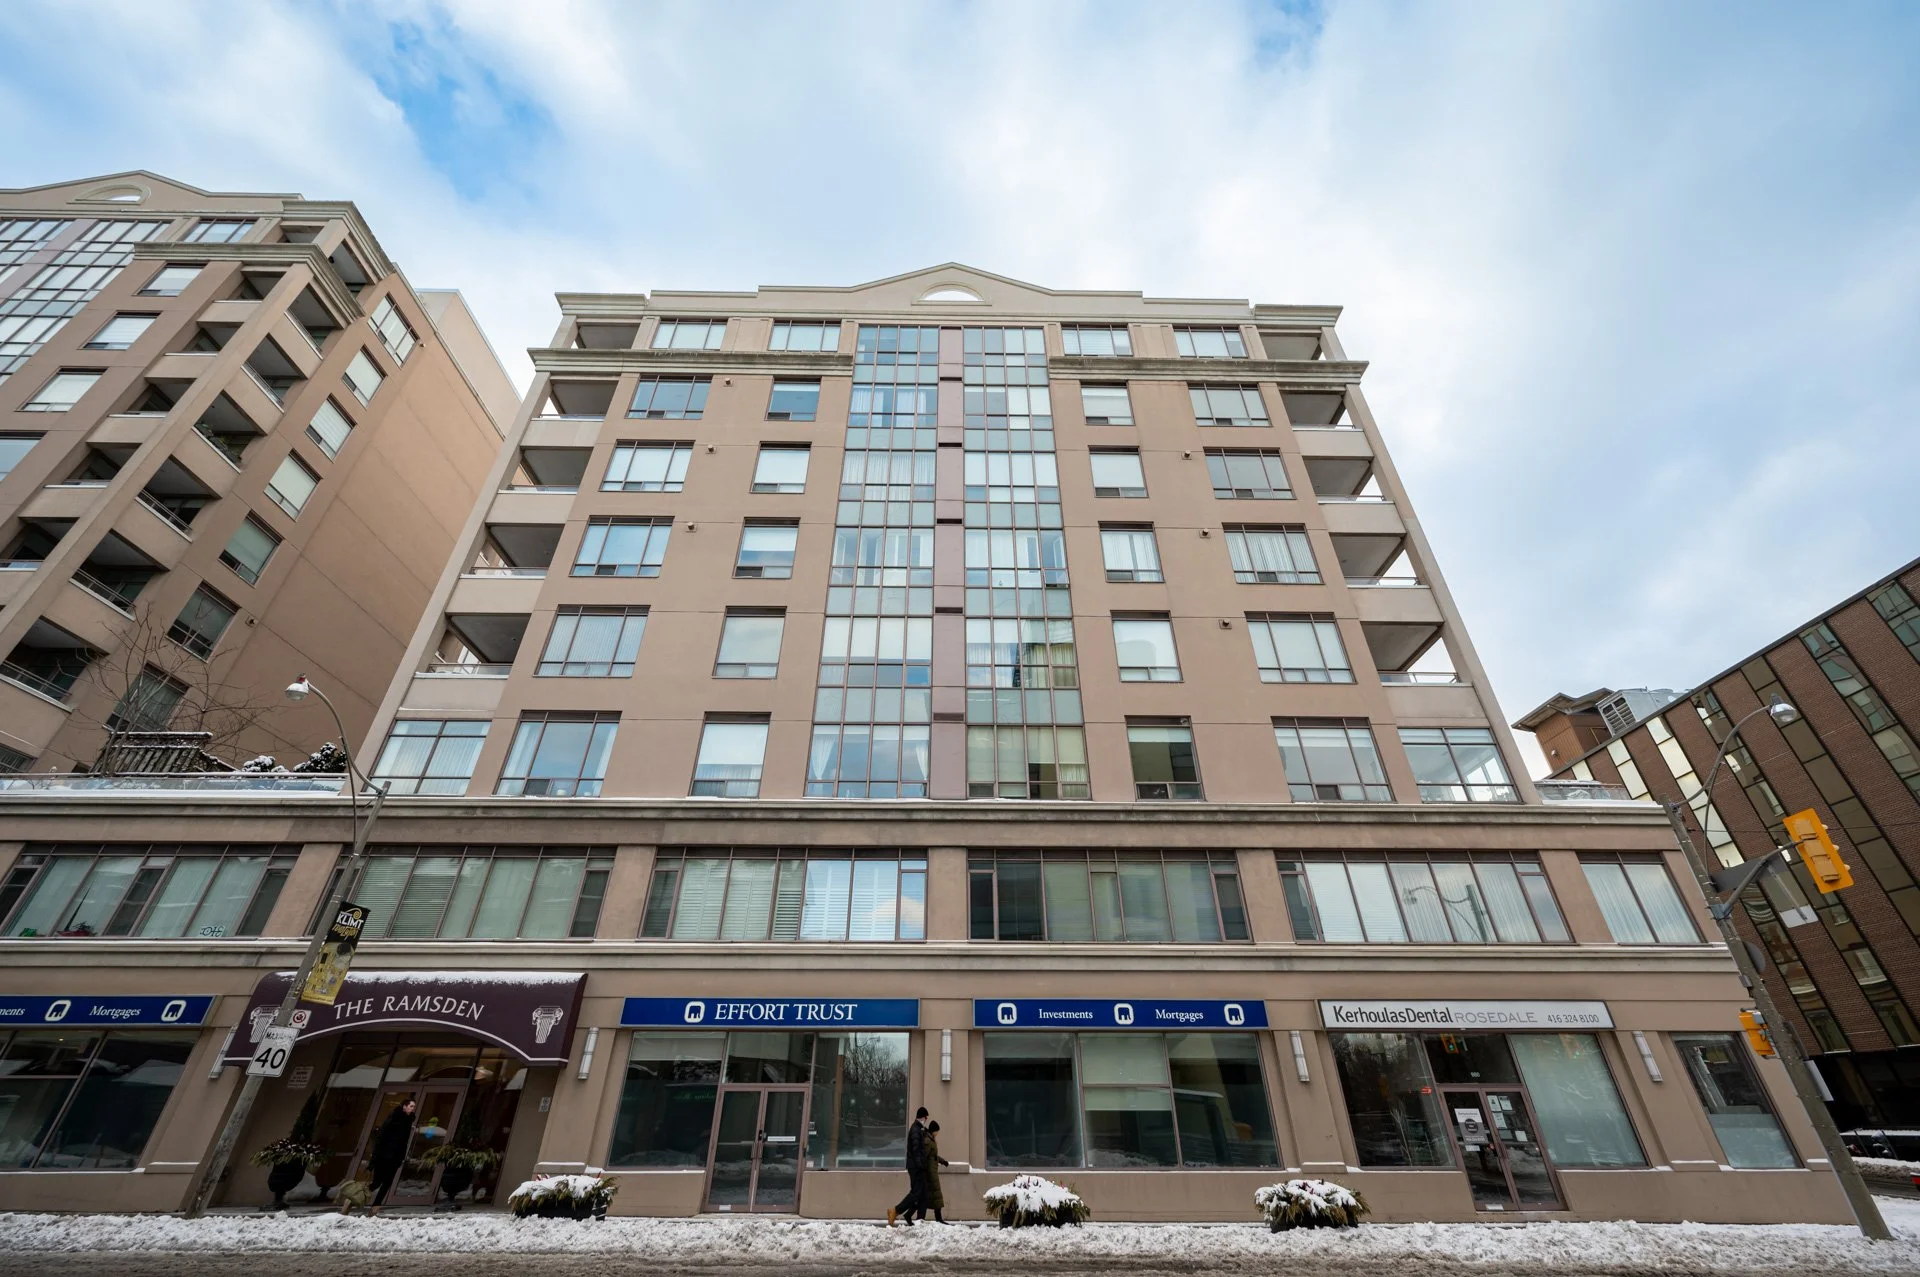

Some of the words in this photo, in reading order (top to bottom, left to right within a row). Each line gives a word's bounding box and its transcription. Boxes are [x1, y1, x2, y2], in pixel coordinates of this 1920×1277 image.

[337, 913, 364, 929] KLIMT
[89, 1005, 141, 1019] Mortgages
[334, 998, 375, 1020] THE
[382, 995, 485, 1021] RAMSDEN
[714, 1003, 789, 1020] EFFORT
[793, 1003, 858, 1021] TRUST
[1038, 1008, 1093, 1019] Investments
[1155, 1008, 1204, 1022] Mortgages
[1333, 1005, 1454, 1023] KerhoulasDental
[1454, 1012, 1538, 1024] ROSEDALE
[1547, 1014, 1562, 1024] 416
[1564, 1014, 1578, 1024] 324
[1580, 1014, 1600, 1023] 8100
[255, 1047, 286, 1069] 40
